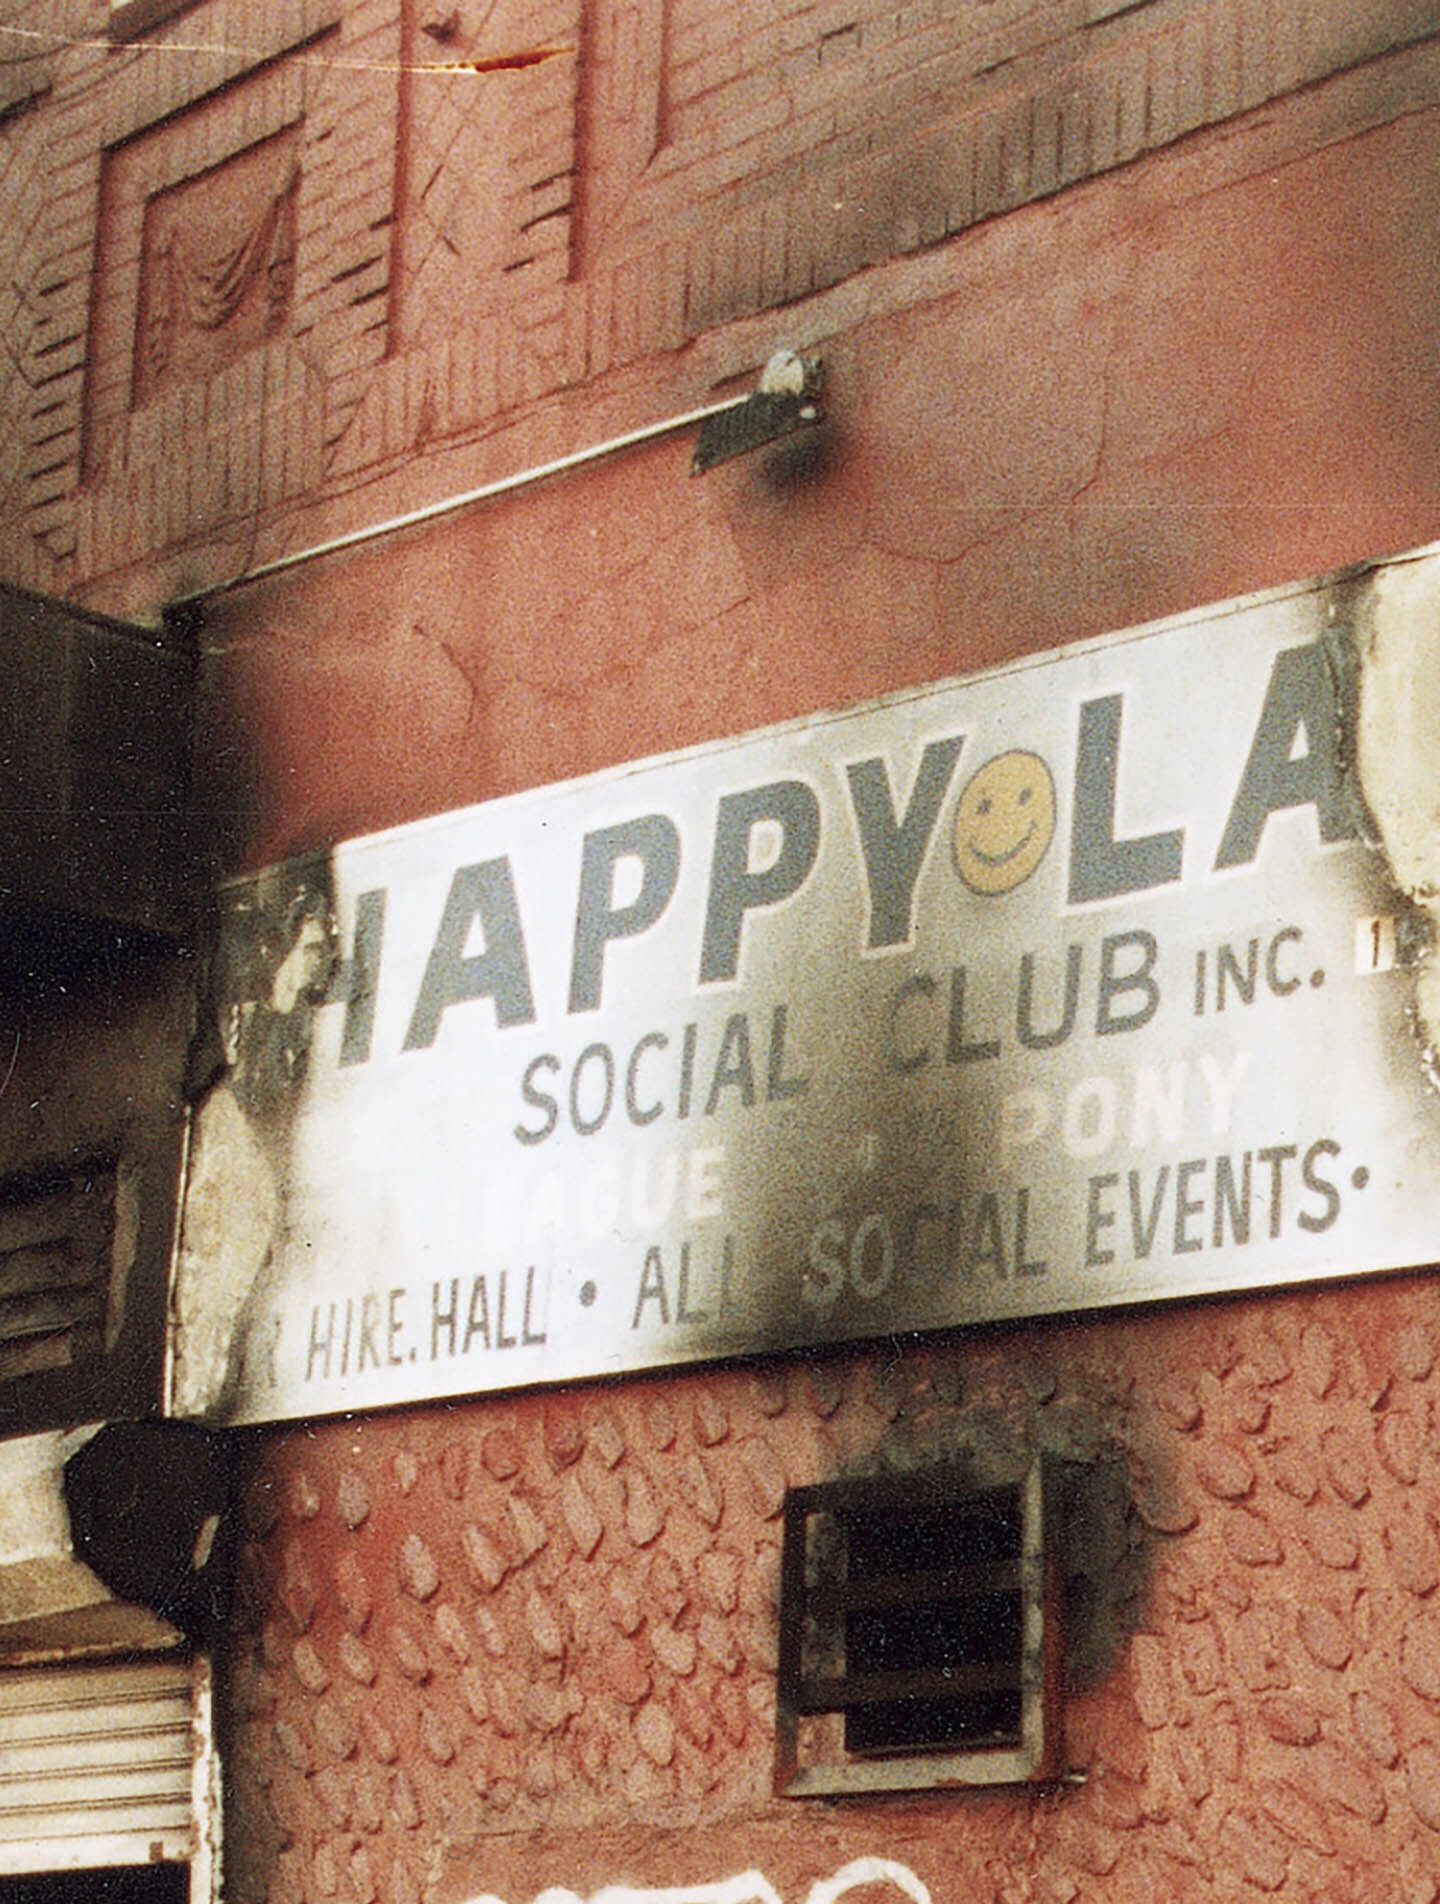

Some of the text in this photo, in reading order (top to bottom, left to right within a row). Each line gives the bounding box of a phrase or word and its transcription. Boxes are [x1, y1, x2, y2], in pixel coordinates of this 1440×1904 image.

[513, 925, 1327, 1147] SOCIAL CLUB INC.
[1084, 1137, 1344, 1271] EVENTS
